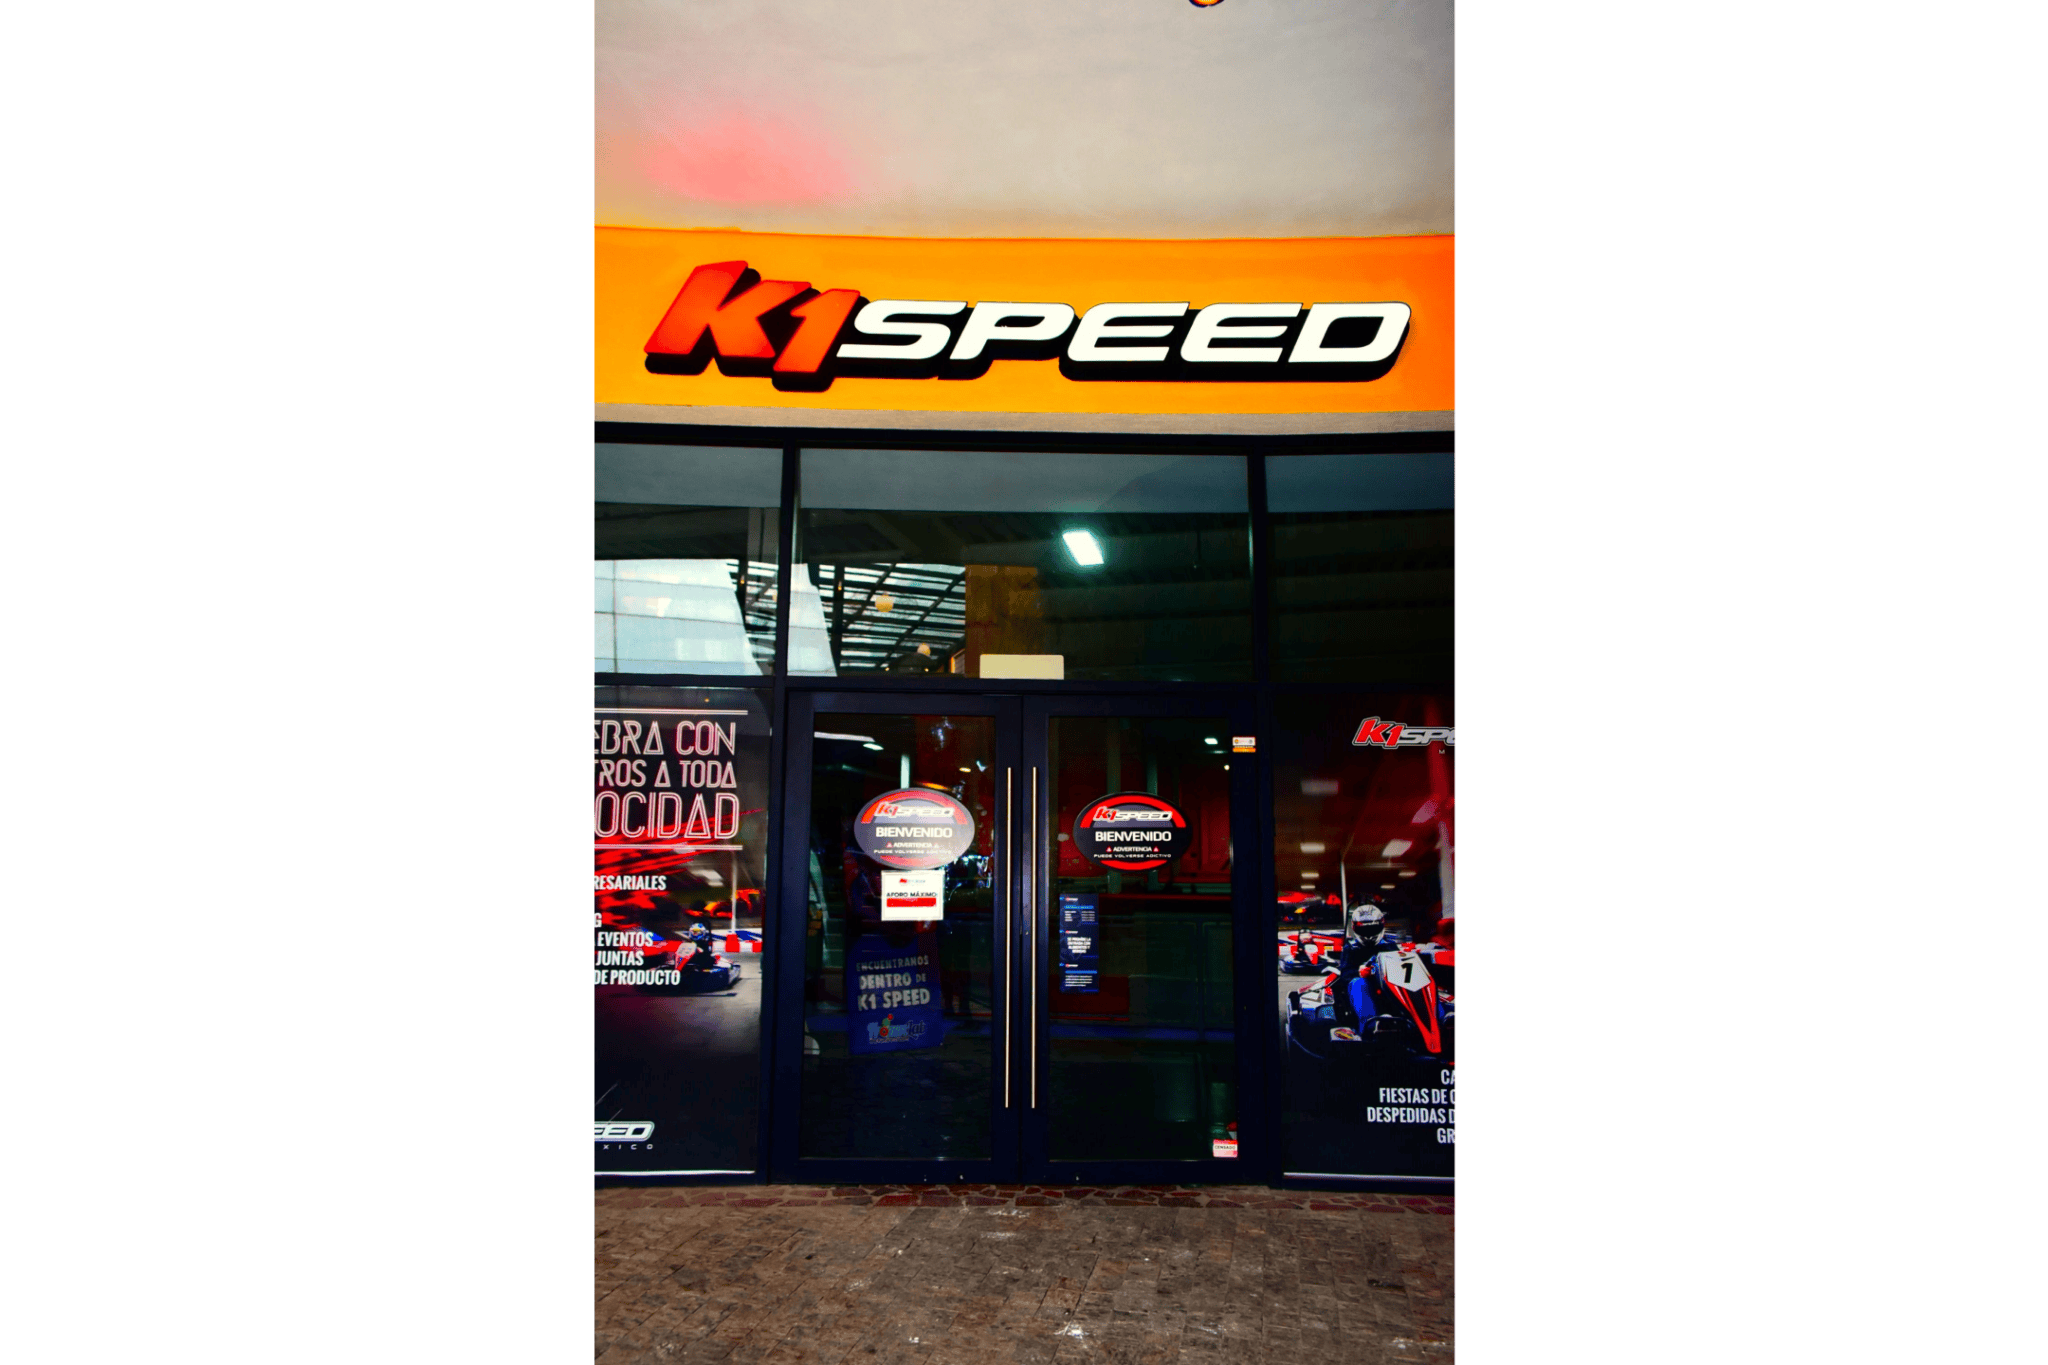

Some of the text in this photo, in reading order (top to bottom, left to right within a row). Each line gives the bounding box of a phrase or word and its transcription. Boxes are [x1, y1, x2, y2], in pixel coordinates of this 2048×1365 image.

[676, 721, 736, 755] CON
[654, 760, 671, 787] A
[679, 760, 737, 788] TODA
[594, 791, 740, 839] OCIDAD
[875, 826, 953, 838] BIENVENIDO
[1094, 830, 1172, 842] BIENVENIDO
[597, 931, 654, 947] EVENTOS
[595, 950, 644, 966] JUNTAS
[594, 969, 681, 986] DE PRODUCTO
[859, 972, 927, 990] DENTRO DE
[1400, 962, 1414, 984] 1
[857, 988, 931, 1011] K1 SPEED
[1379, 1087, 1430, 1104] FIESTAS
[1431, 1088, 1448, 1104] DE
[1367, 1106, 1446, 1124] DESPEDIDAS
